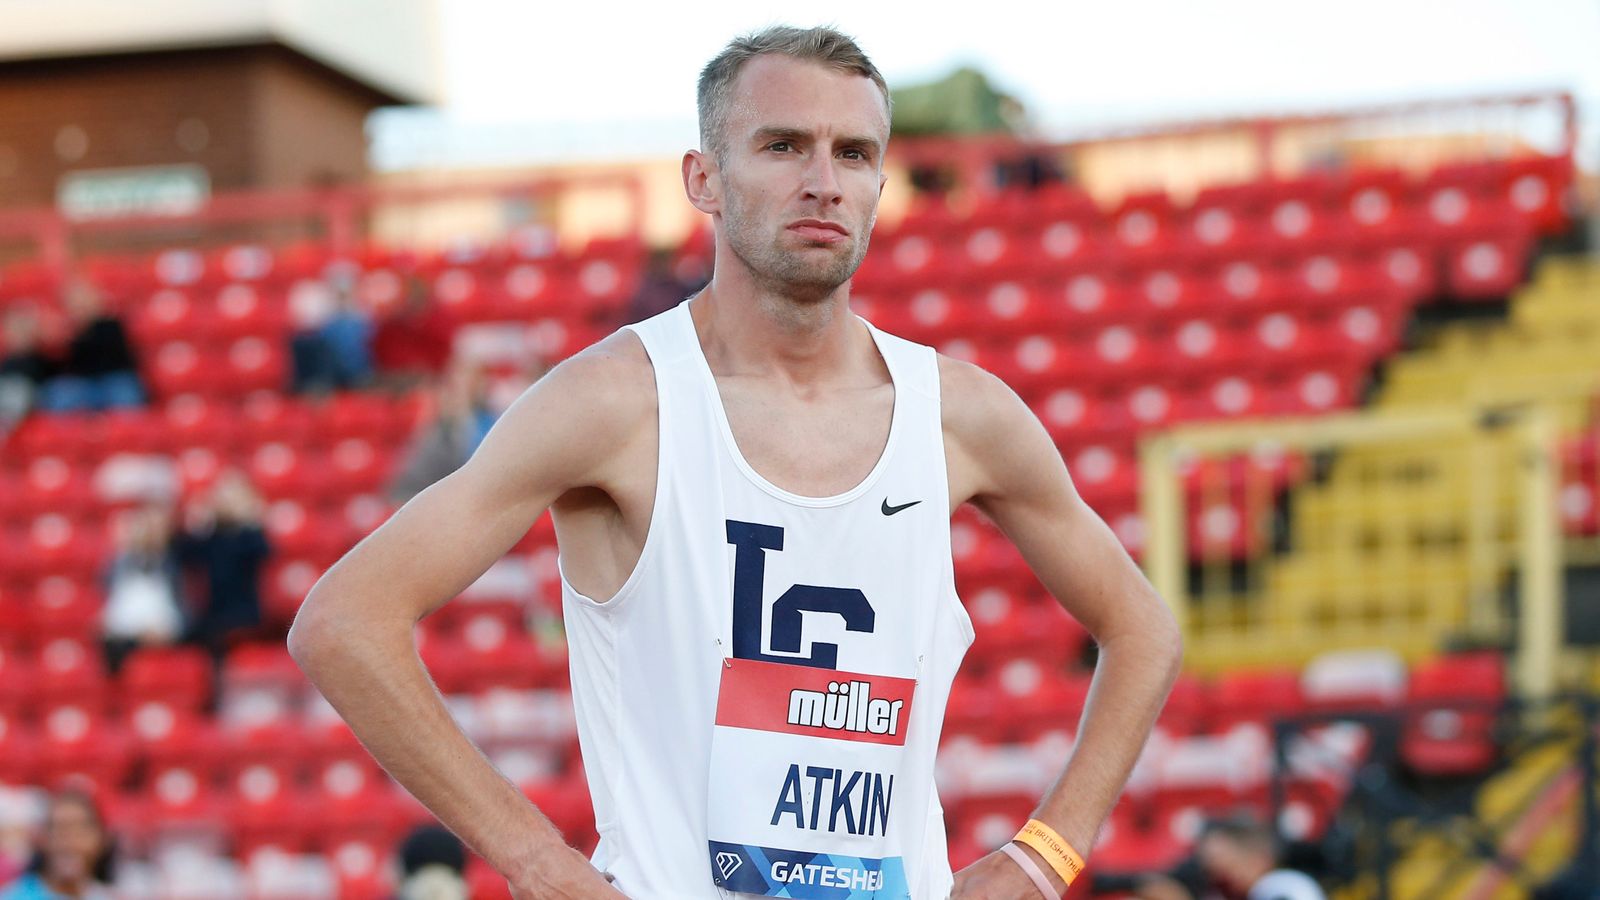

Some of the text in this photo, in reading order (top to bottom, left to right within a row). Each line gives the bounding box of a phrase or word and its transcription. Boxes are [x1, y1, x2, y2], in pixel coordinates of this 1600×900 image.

[787, 680, 903, 736] müller
[770, 763, 894, 837] ATKIN
[1034, 829, 1064, 856] BRITISH
